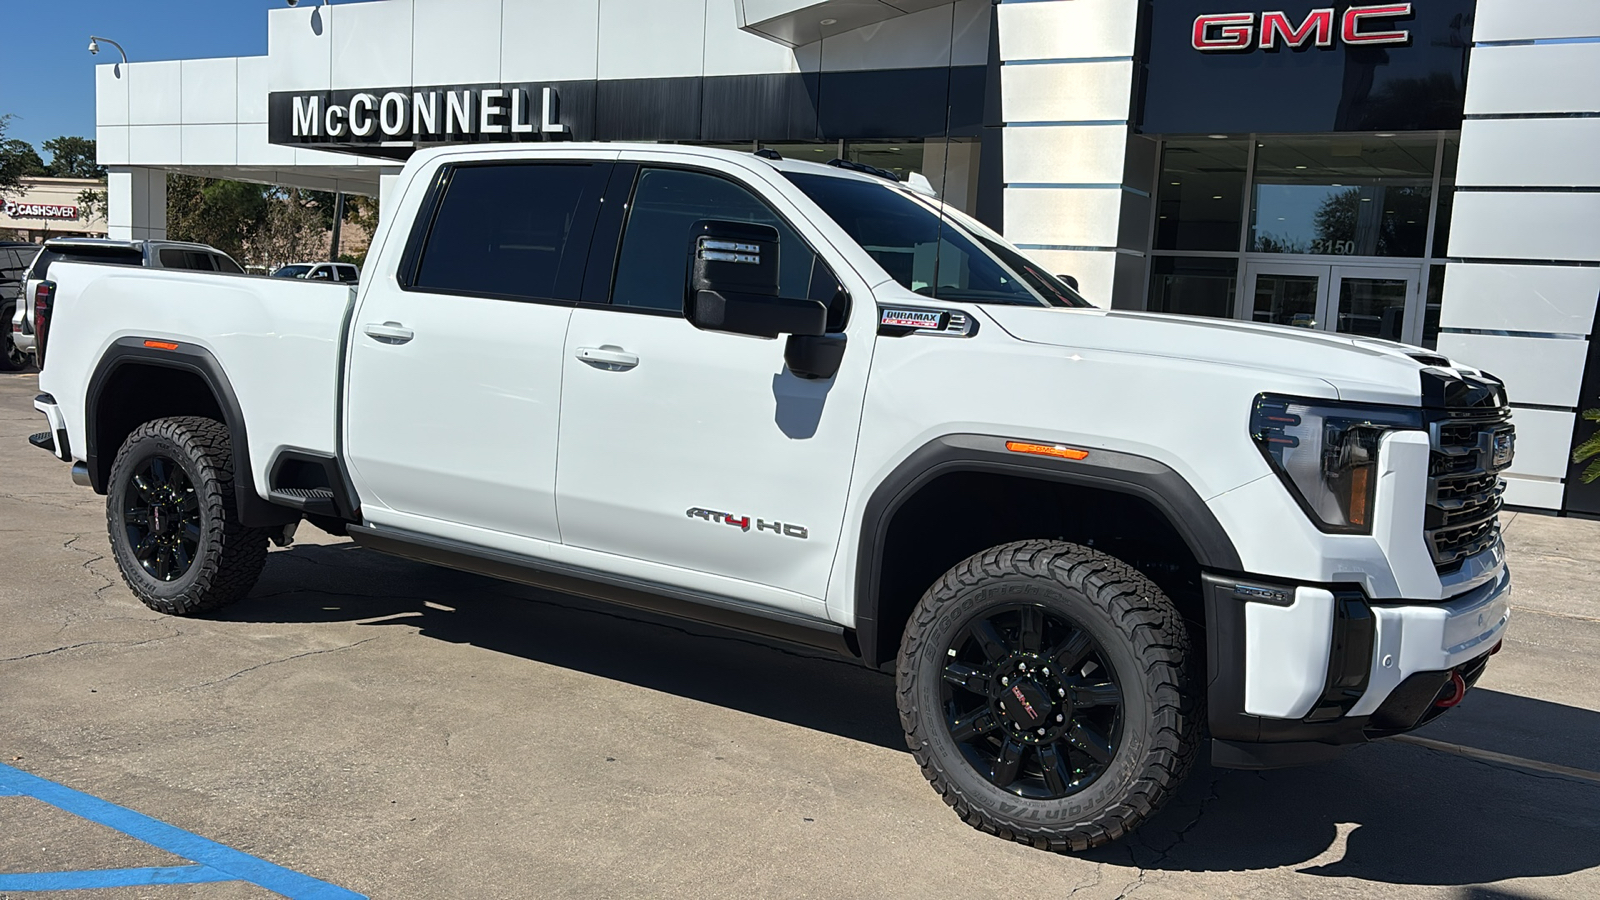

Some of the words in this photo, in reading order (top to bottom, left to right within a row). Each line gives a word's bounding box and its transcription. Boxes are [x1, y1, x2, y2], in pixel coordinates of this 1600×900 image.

[1192, 3, 1411, 50] GMC
[292, 87, 565, 137] McCONNELL
[18, 205, 74, 218] CASHSAVER
[1315, 239, 1355, 254] 3150
[886, 311, 937, 322] DURAMAX
[686, 507, 751, 533] AT4
[756, 518, 808, 540] HD
[924, 584, 1039, 664] BFGoodrich
[1012, 685, 1038, 720] GMC
